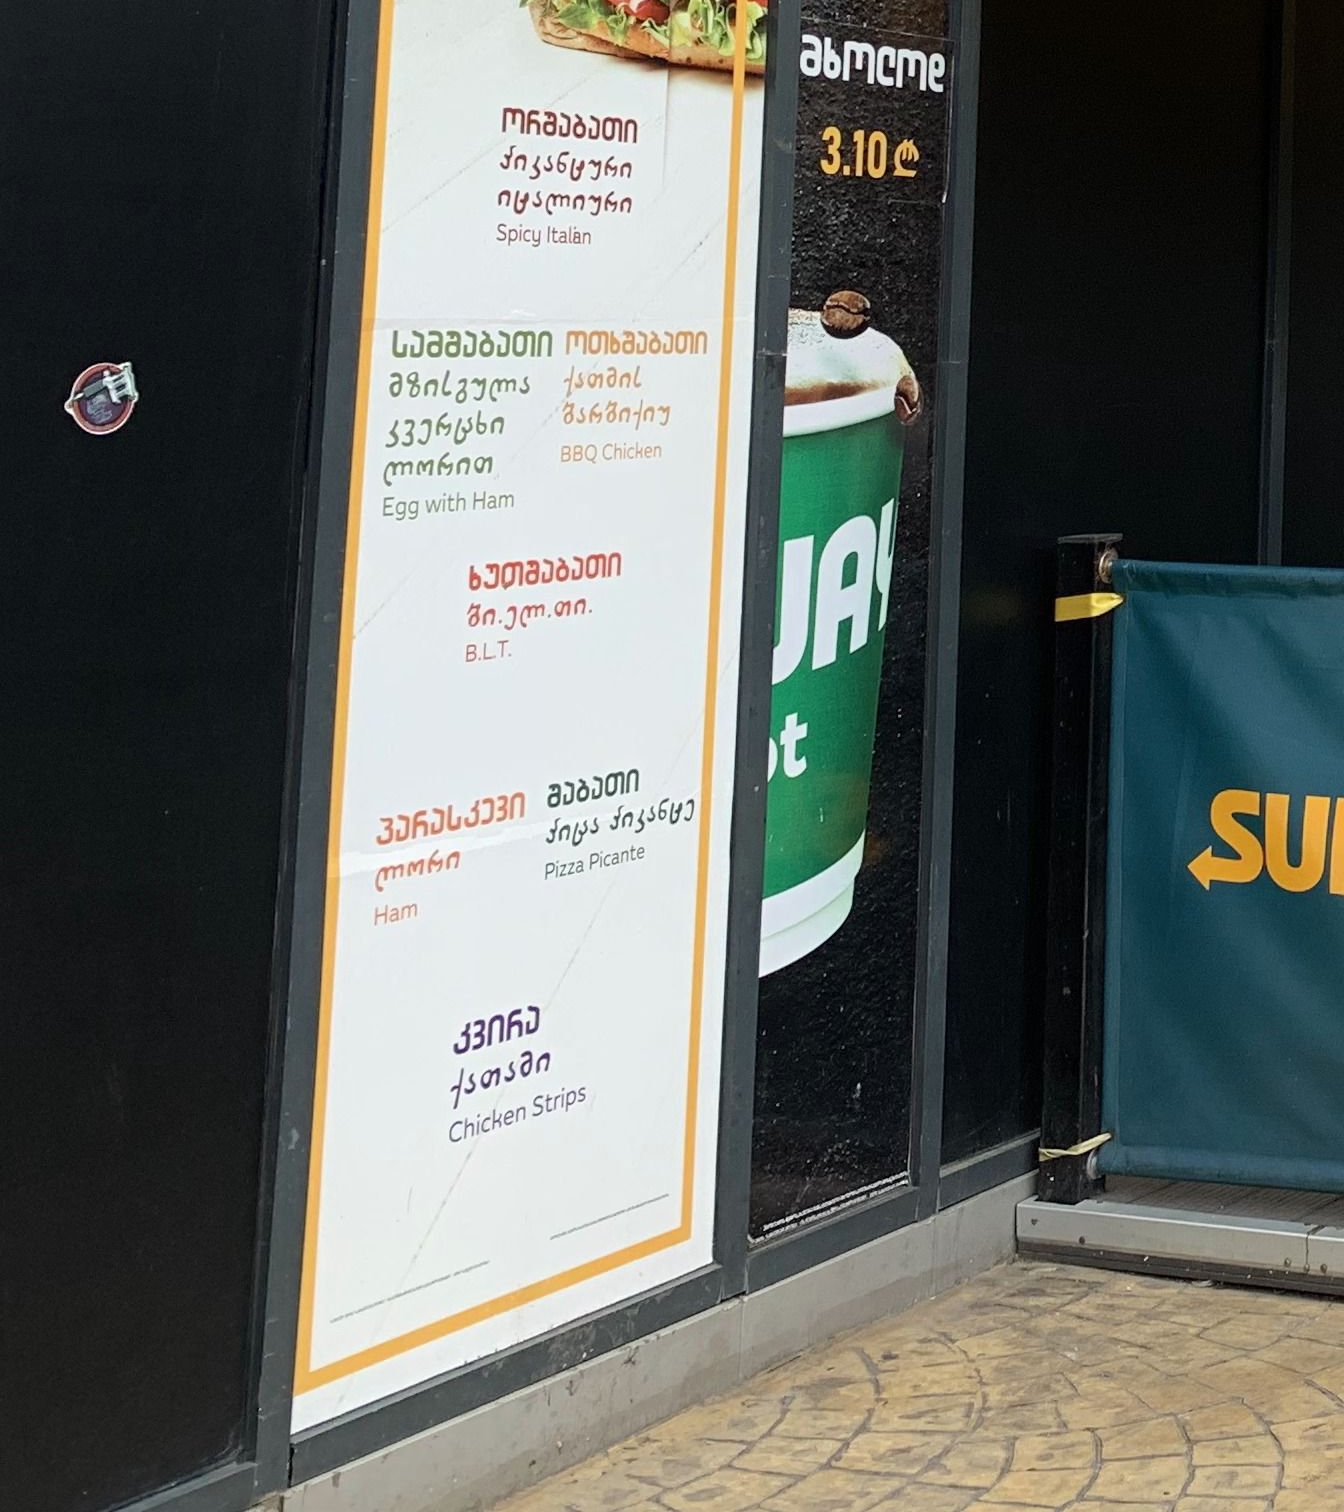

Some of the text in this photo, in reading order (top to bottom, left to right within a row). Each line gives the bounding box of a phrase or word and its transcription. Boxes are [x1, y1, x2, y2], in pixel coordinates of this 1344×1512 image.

[800, 34, 946, 93] მხოლოდ
[502, 107, 638, 144] ორშაბათი
[500, 146, 632, 181] პიკანტური
[820, 126, 887, 179] 3.10
[497, 189, 632, 215] იტალიური
[496, 223, 541, 247] Spicy
[391, 330, 708, 359] სამშაბათი ოთხშაბათი
[389, 370, 531, 404] მზისგულა
[563, 365, 642, 402] ქათმის
[385, 410, 505, 448] კვერცხი
[562, 399, 672, 431] ბარბიქიუ
[383, 452, 493, 486] ლორით
[561, 442, 662, 464] BBQ Chicken
[382, 490, 515, 521] Egg with Ham
[468, 551, 622, 591] ხუთშაბათი
[465, 640, 513, 663] B.L.T.
[547, 768, 640, 809] შაბათი
[376, 791, 526, 846] პარასკევი
[545, 797, 696, 848] პიცა პიკანტე
[375, 850, 461, 892] ლორი
[544, 845, 646, 881] Pizza Picante
[374, 902, 418, 926] Ham
[453, 1005, 541, 1055] კვირა
[450, 1050, 551, 1110] ქათამი
[448, 1085, 587, 1143] Chicken Strips
